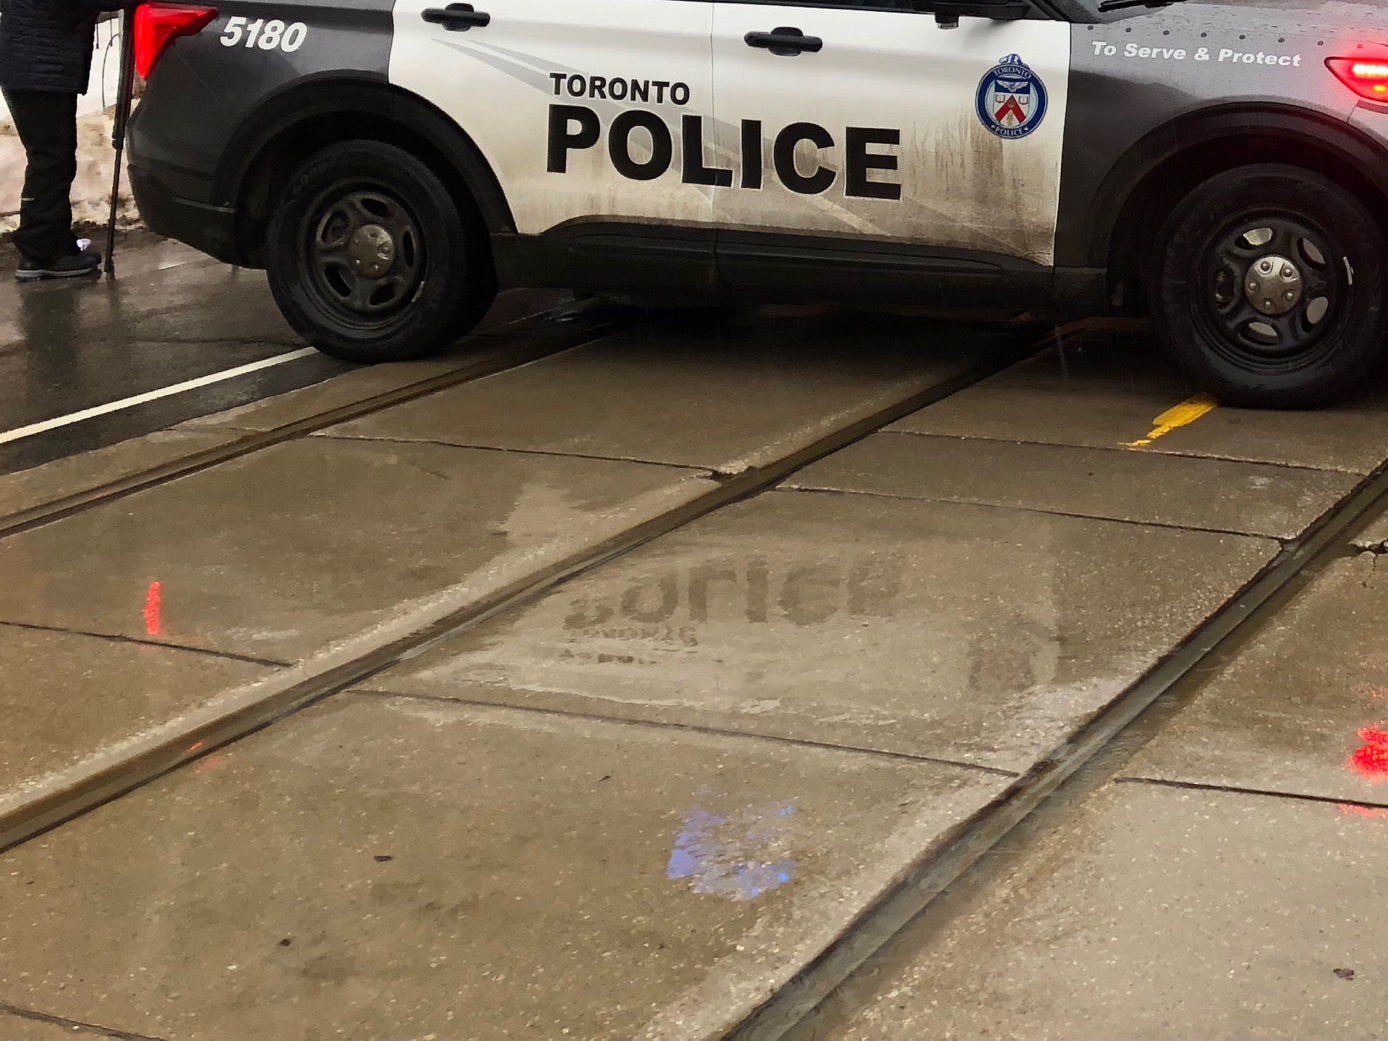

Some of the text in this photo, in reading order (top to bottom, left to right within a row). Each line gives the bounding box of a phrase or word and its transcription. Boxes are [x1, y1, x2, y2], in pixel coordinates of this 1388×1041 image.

[220, 16, 308, 53] 5180
[1091, 41, 1302, 67] To Serve & Protect
[993, 66, 1032, 80] TORONTO
[550, 73, 690, 106] TORONTO
[994, 126, 1023, 136] POLICE
[547, 104, 901, 200] POLICE
